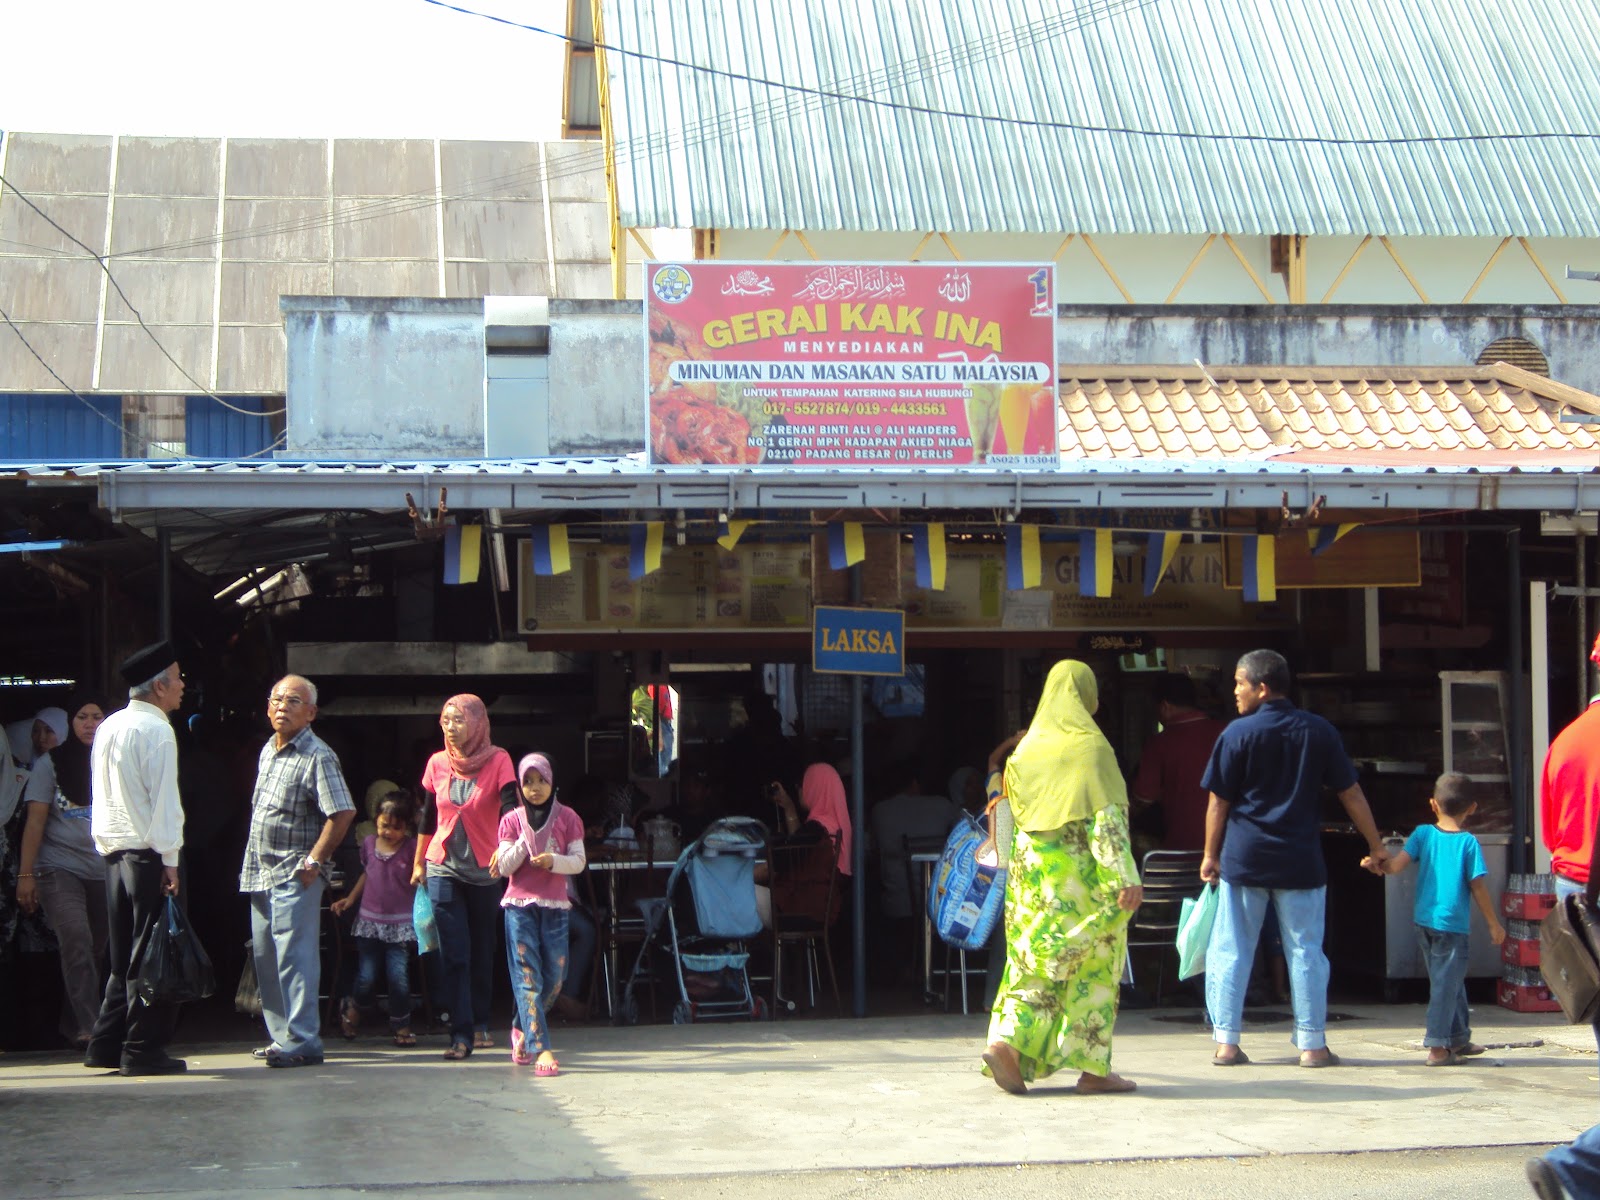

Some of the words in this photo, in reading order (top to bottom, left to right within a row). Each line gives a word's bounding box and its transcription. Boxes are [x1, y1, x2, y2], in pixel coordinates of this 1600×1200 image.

[702, 304, 828, 348] GERAI
[840, 303, 924, 337] KAK
[933, 310, 1003, 352] INA
[784, 341, 924, 353] MENYEDIAKAN
[678, 364, 762, 379] MINUMAN
[769, 364, 805, 380] DAN
[811, 364, 895, 380] MASAKAN
[902, 365, 947, 380] SATU
[953, 365, 1038, 381] MALAYSIA
[743, 388, 778, 397] UNTUK
[781, 388, 838, 397] TEMPAHAN
[844, 388, 896, 397] KATERING
[899, 388, 923, 398] SILA
[926, 388, 973, 398] HUBUNGI
[762, 402, 791, 415] 017-
[794, 402, 880, 416] 5527874/019
[891, 402, 947, 416] 4433561
[762, 425, 815, 435] ZARENAH
[819, 425, 849, 435] BINTI
[853, 425, 870, 435] ALI
[886, 425, 904, 435] ALI
[908, 425, 957, 435] HAIDERS
[748, 437, 774, 447] NO.1
[778, 437, 812, 447] GERAI
[816, 437, 841, 447] MPK
[844, 437, 897, 447] HADAPAN
[938, 437, 973, 447] NIAGA
[767, 449, 801, 459] 02100
[805, 449, 850, 459] PADANG
[855, 449, 891, 459] BESAR
[894, 449, 910, 460] (U)
[914, 449, 953, 459] PERLIS
[1054, 555, 1132, 584] GAI
[821, 628, 897, 654] LAKSA
